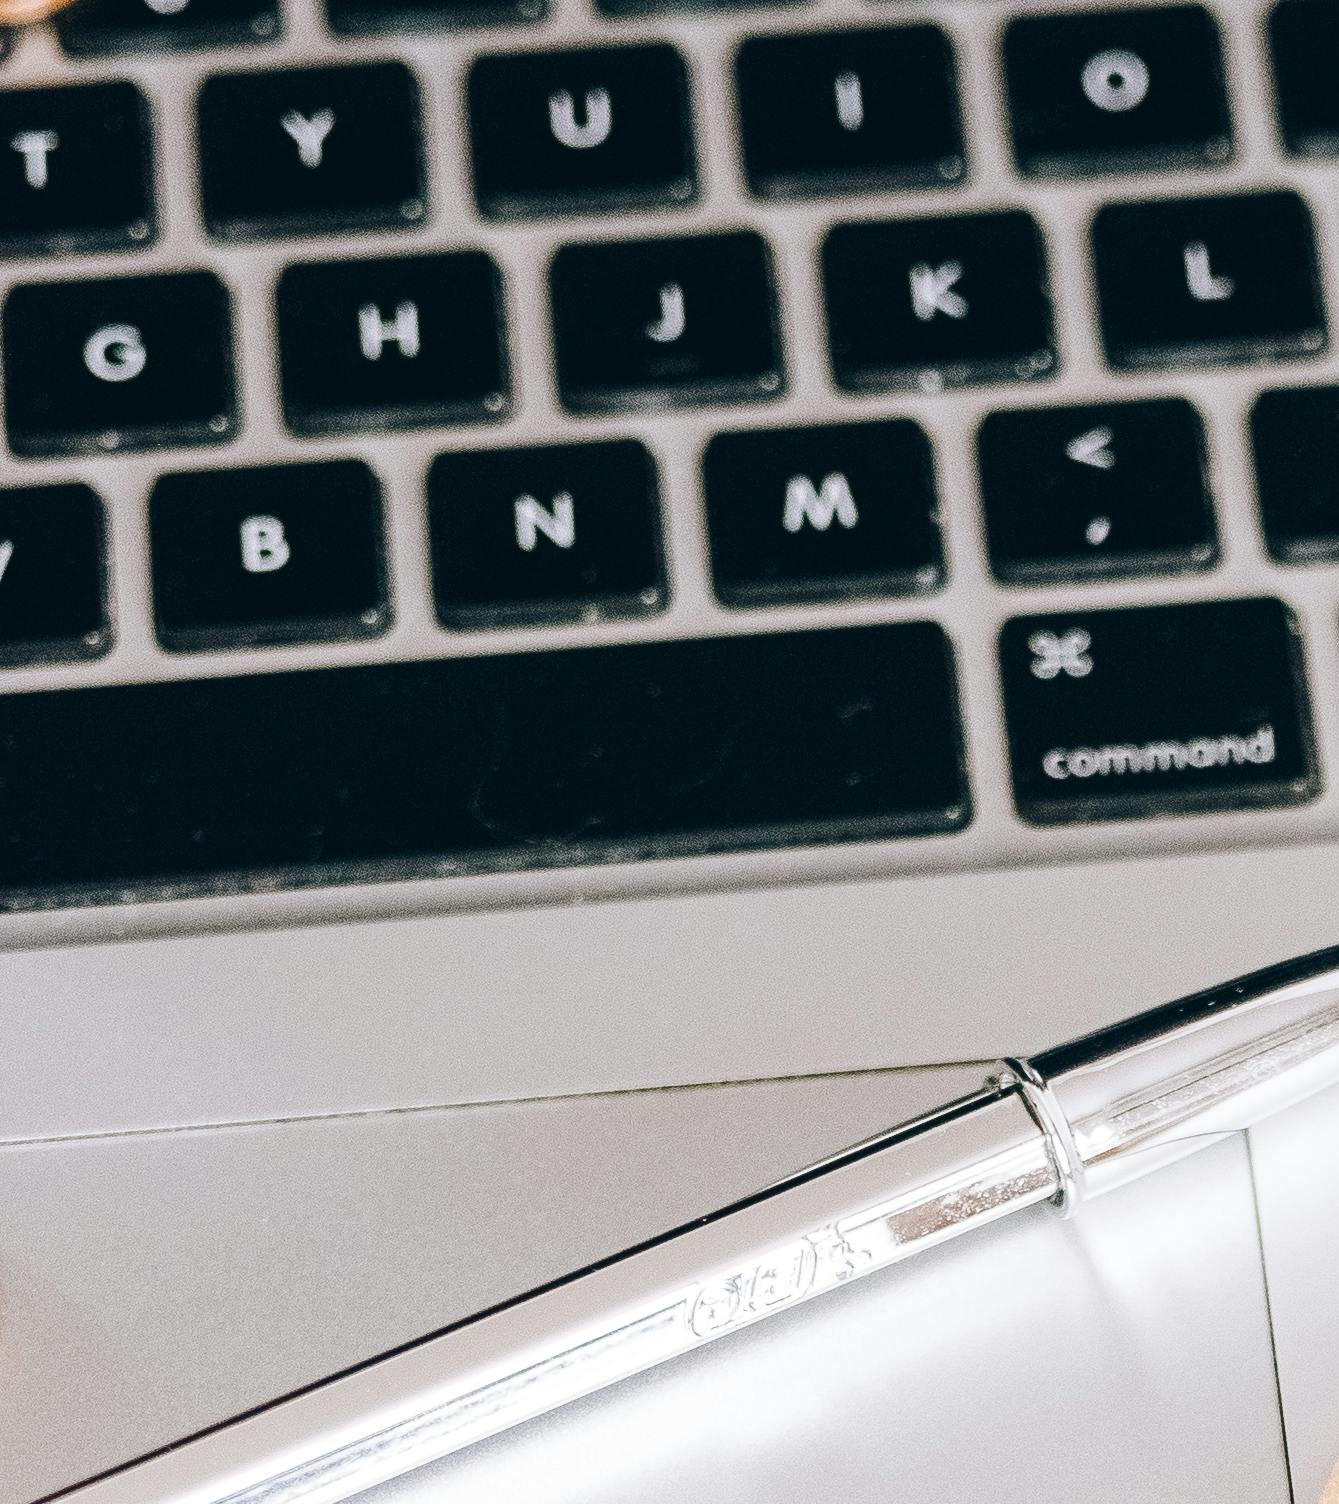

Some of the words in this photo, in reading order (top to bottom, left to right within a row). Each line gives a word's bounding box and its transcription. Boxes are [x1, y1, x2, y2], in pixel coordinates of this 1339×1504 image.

[13, 131, 56, 187] T
[283, 111, 333, 166] Y
[549, 91, 612, 148] U
[835, 75, 863, 129] I
[1082, 52, 1148, 110] O
[84, 325, 146, 382] G
[359, 304, 420, 359] H
[649, 286, 685, 342] J
[910, 265, 965, 319] K
[1184, 245, 1231, 300] L
[241, 517, 289, 572] B
[515, 495, 574, 549] N
[785, 475, 857, 531] M
[1043, 727, 1276, 779] command
